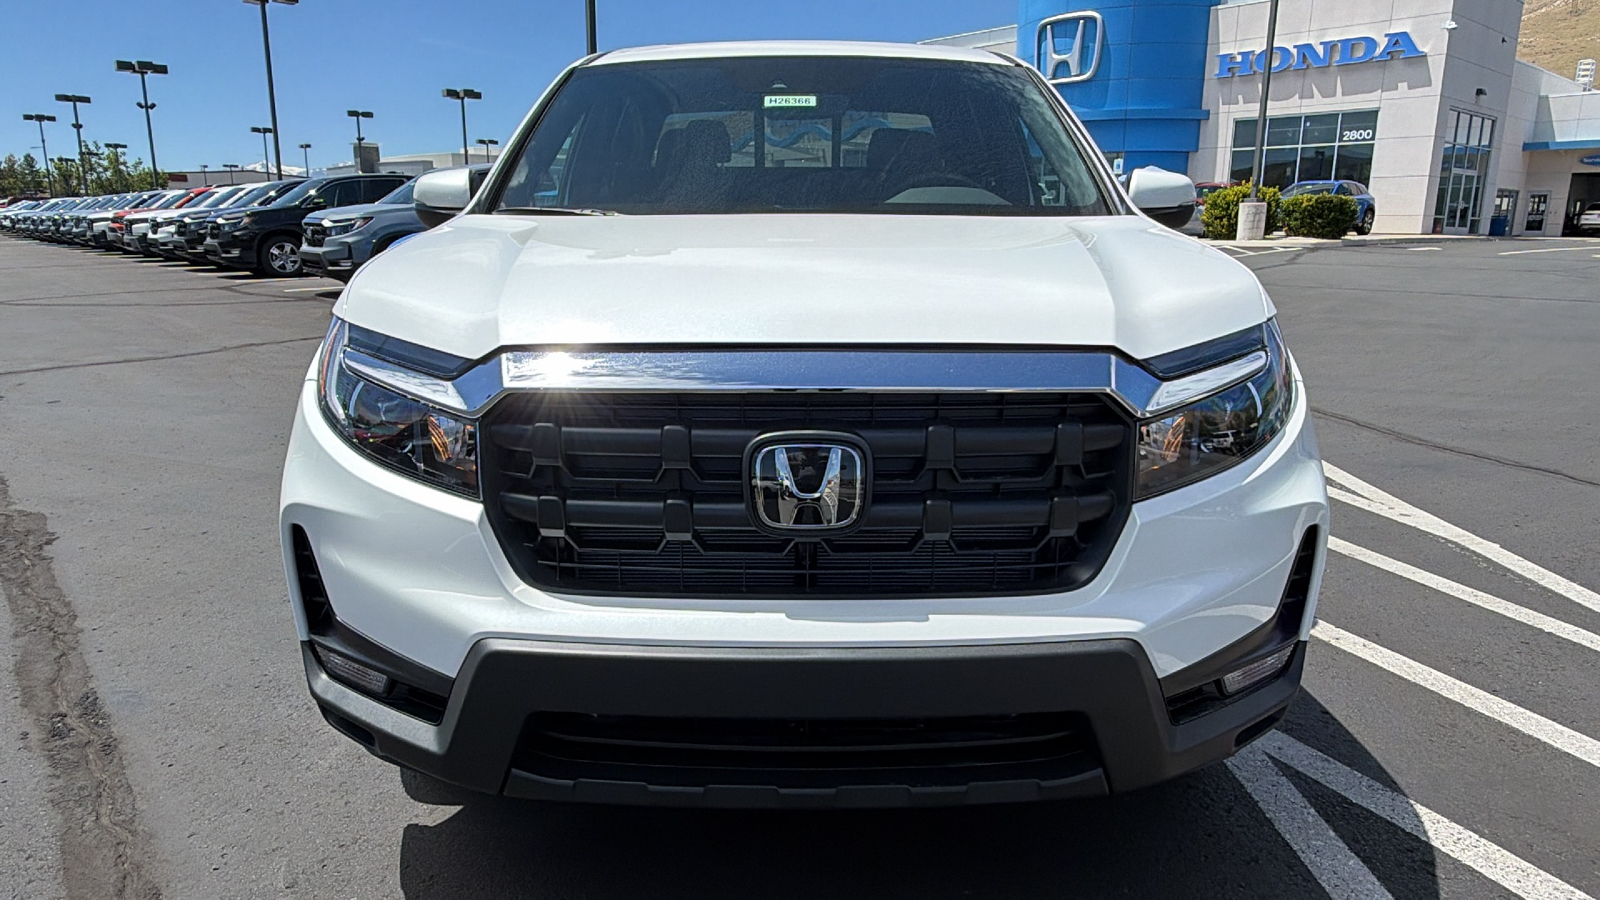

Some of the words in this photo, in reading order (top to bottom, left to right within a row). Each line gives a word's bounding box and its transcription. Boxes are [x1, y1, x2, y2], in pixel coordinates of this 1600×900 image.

[1214, 31, 1427, 78] HONDA
[769, 97, 811, 105] H26366
[1343, 130, 1373, 140] 2800
